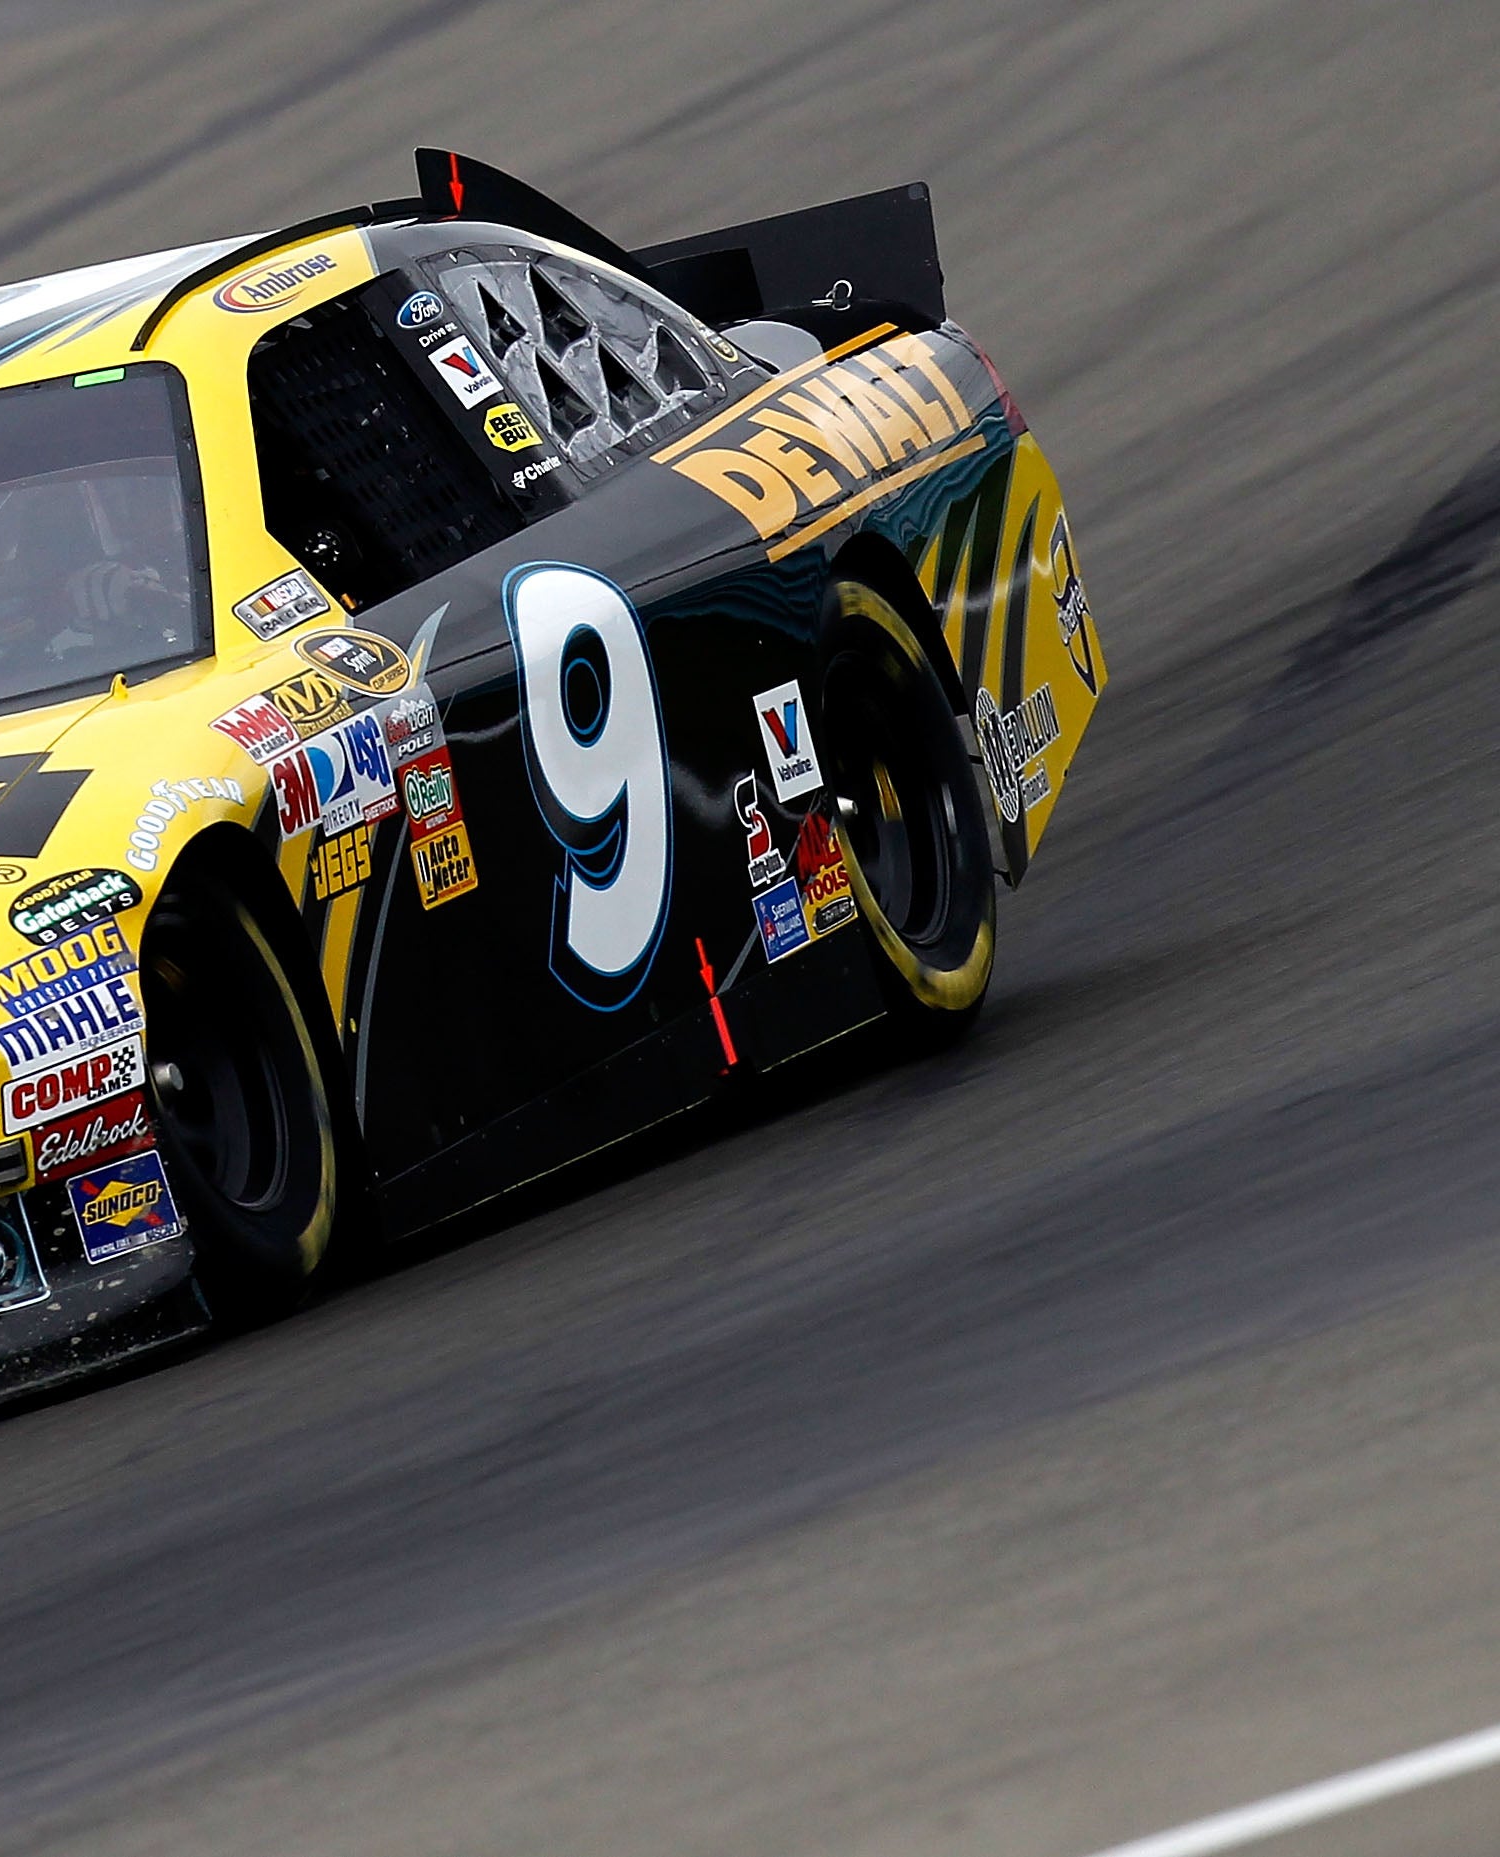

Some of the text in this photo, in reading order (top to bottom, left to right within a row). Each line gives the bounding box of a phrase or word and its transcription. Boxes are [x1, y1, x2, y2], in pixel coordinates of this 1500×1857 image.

[240, 253, 337, 303] Ambrose
[410, 297, 440, 323] Ford
[418, 326, 451, 349] Drive
[489, 411, 528, 433] BEST
[500, 425, 534, 447] BUY
[671, 332, 975, 541] DEWALT
[525, 455, 562, 481] Charter
[264, 579, 306, 610] NASCAR
[260, 597, 326, 633] RACE CAR
[342, 647, 377, 675] Sprint
[212, 702, 295, 750] Holley
[407, 704, 435, 733] LIGHT
[260, 732, 289, 754] CARBS
[343, 715, 392, 787] USG
[398, 731, 433, 758] POLE
[508, 564, 670, 990] 9
[776, 757, 815, 783] Valvoline
[273, 749, 320, 834] 3M
[405, 768, 453, 820] O'Reilly
[126, 776, 246, 872] GOODYEAR
[321, 798, 362, 832] DIRECTV
[312, 825, 372, 901] JEGS
[429, 834, 460, 867] Auto
[14, 869, 95, 911] GOODYEAR
[431, 857, 471, 892] Meter
[804, 864, 850, 905] TOOLS
[13, 873, 132, 934] Gatorback
[38, 892, 134, 943] BELTS
[14, 975, 83, 1014] CHASSIS
[10, 1053, 112, 1119] COMP
[86, 1072, 132, 1101] CAMS
[37, 1103, 149, 1172] Edelbrock
[86, 1183, 158, 1223] SUNOCO
